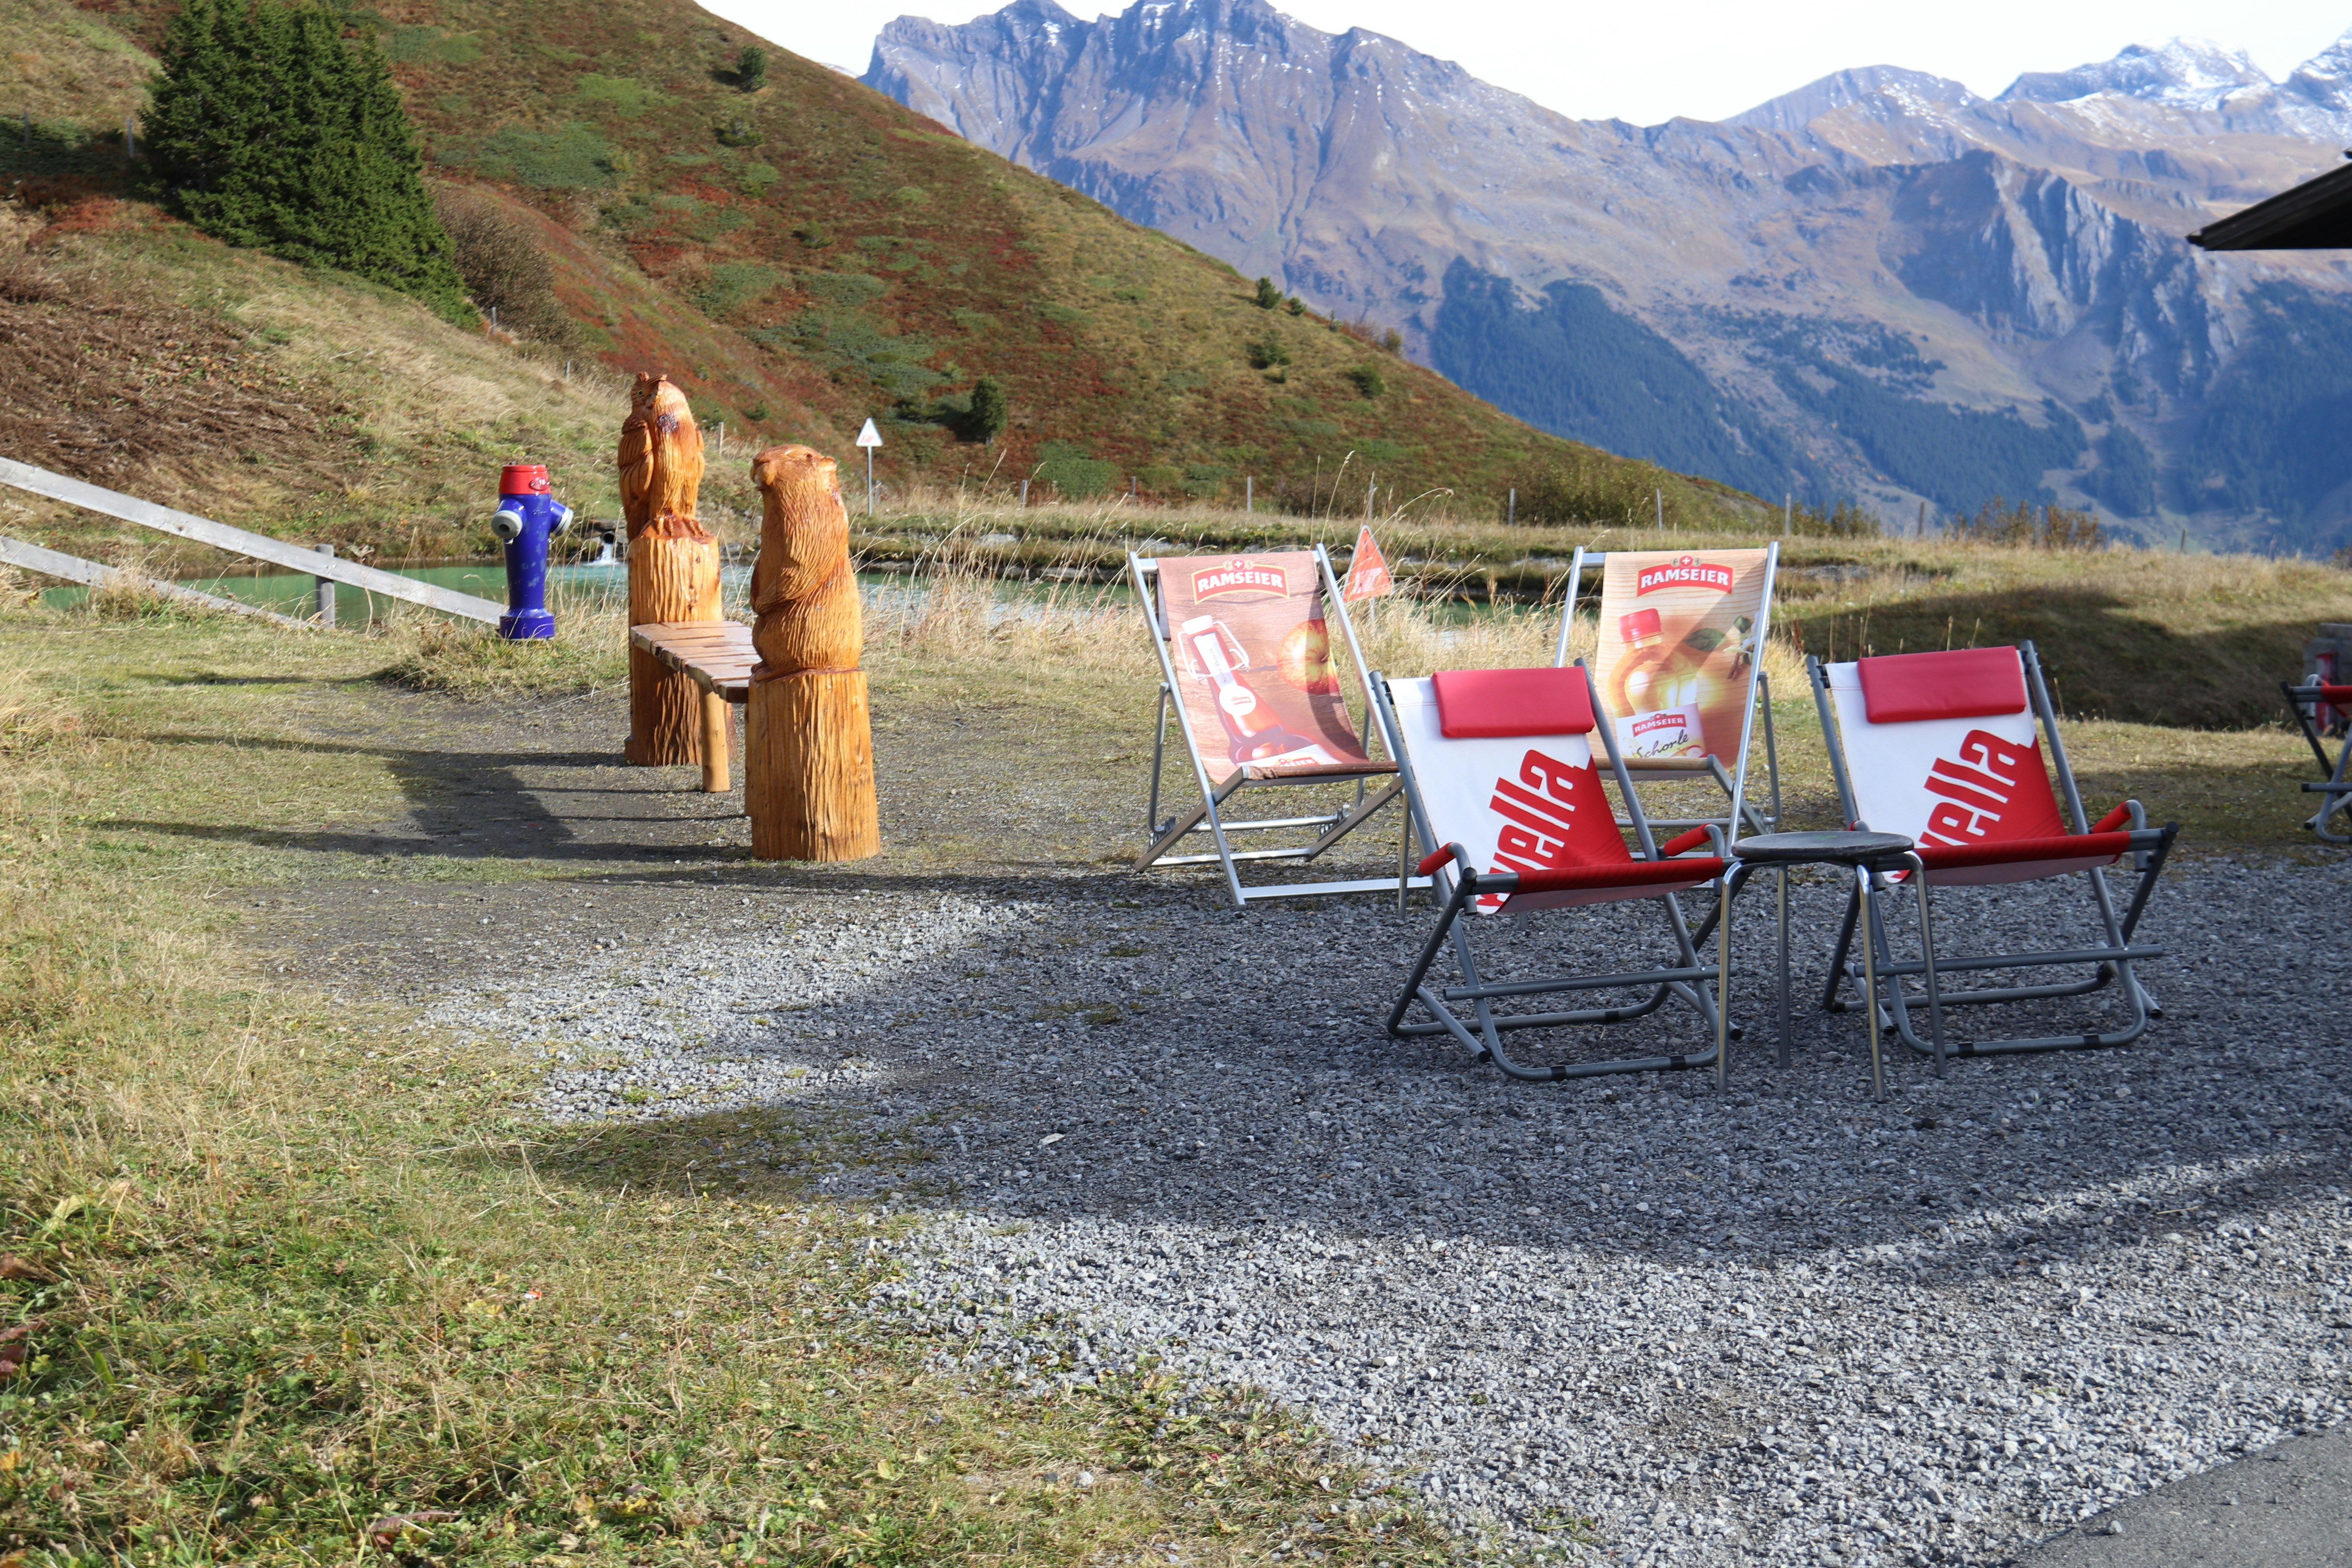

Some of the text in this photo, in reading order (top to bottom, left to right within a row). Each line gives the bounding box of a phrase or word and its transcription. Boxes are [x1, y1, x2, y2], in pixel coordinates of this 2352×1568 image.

[1197, 572, 1283, 593] RAMSEIER
[1640, 569, 1729, 588] RAMSEIER
[1634, 718, 1684, 733] RAMSEIER
[1637, 729, 1689, 758] Schorle
